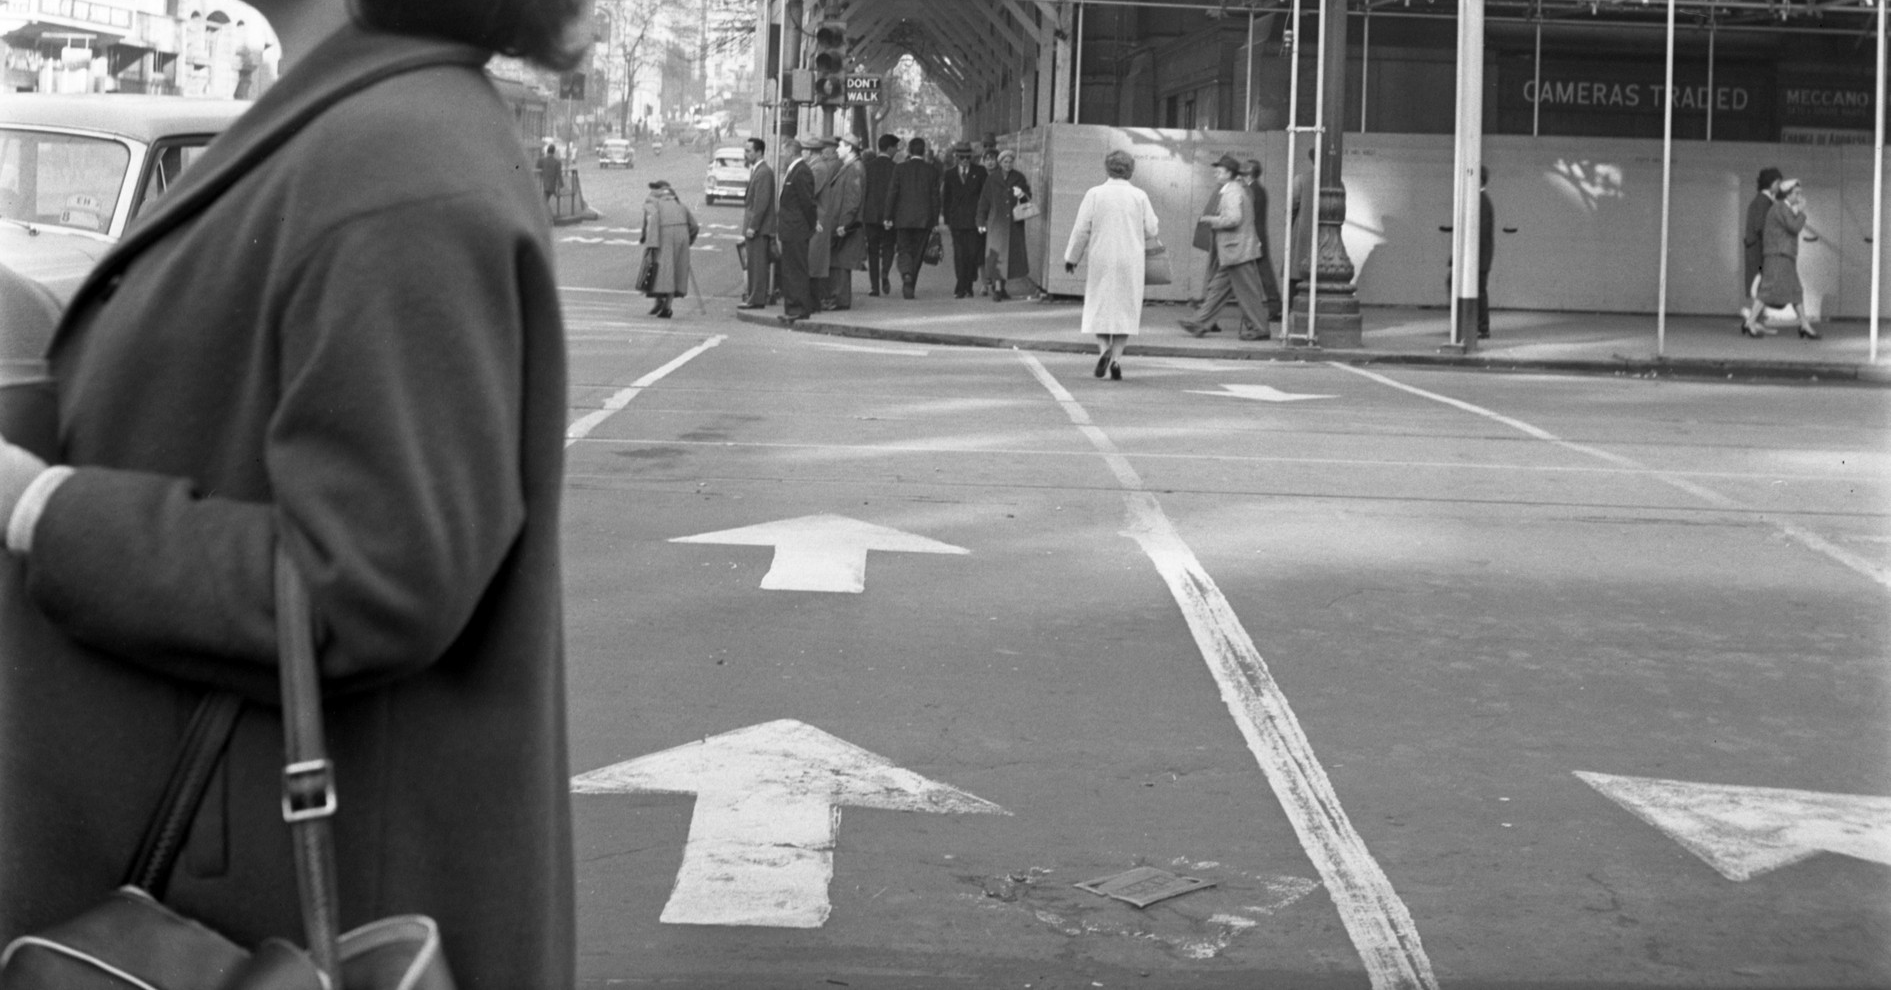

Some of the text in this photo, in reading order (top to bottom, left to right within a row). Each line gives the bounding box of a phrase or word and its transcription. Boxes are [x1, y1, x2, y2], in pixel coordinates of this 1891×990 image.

[847, 92, 878, 102] WALK
[1523, 80, 1749, 110] CAMERAS TRADED
[1786, 90, 1869, 106] MECCANO
